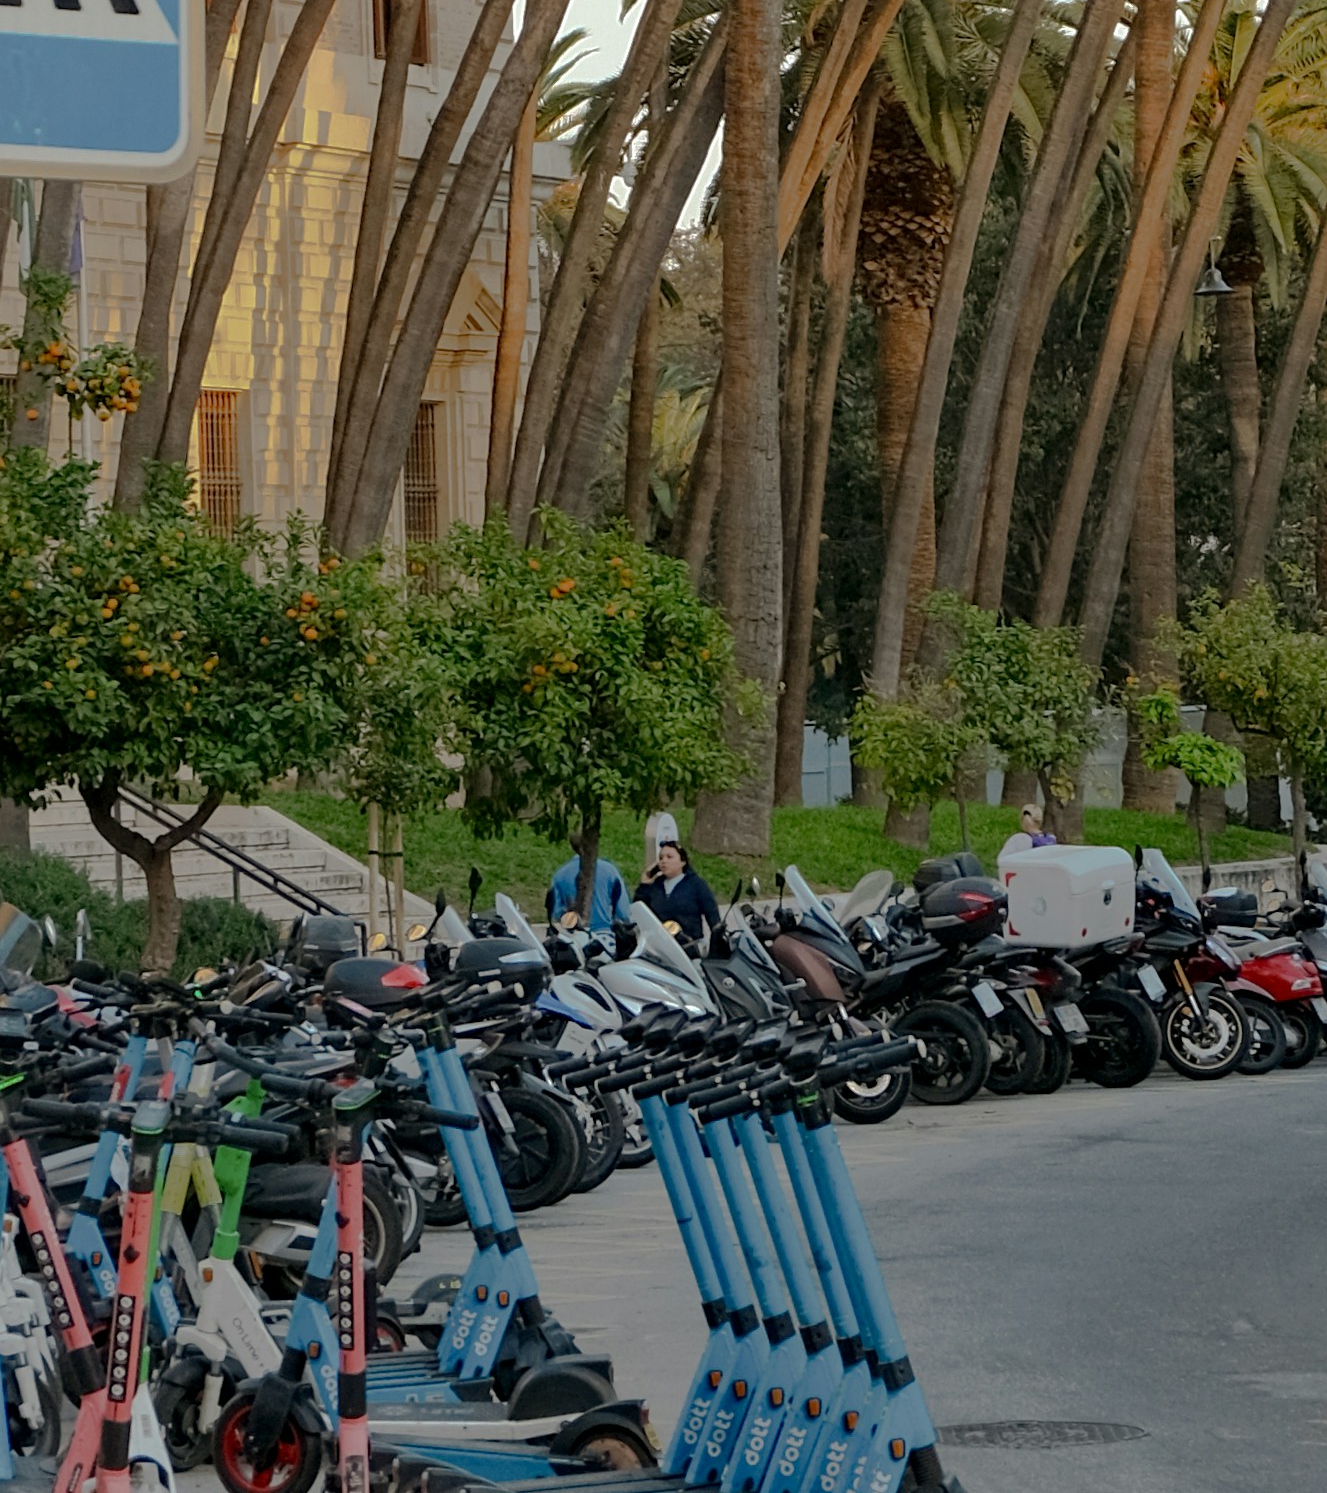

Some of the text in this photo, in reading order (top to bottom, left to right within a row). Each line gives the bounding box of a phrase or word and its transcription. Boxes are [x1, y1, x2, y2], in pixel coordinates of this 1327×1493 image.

[452, 1309, 478, 1350] dott
[474, 1315, 500, 1357] dott
[682, 1397, 712, 1445] dott
[706, 1409, 735, 1458] dott
[744, 1416, 772, 1467] dott
[778, 1426, 808, 1477] dott
[819, 1441, 848, 1492] dott
